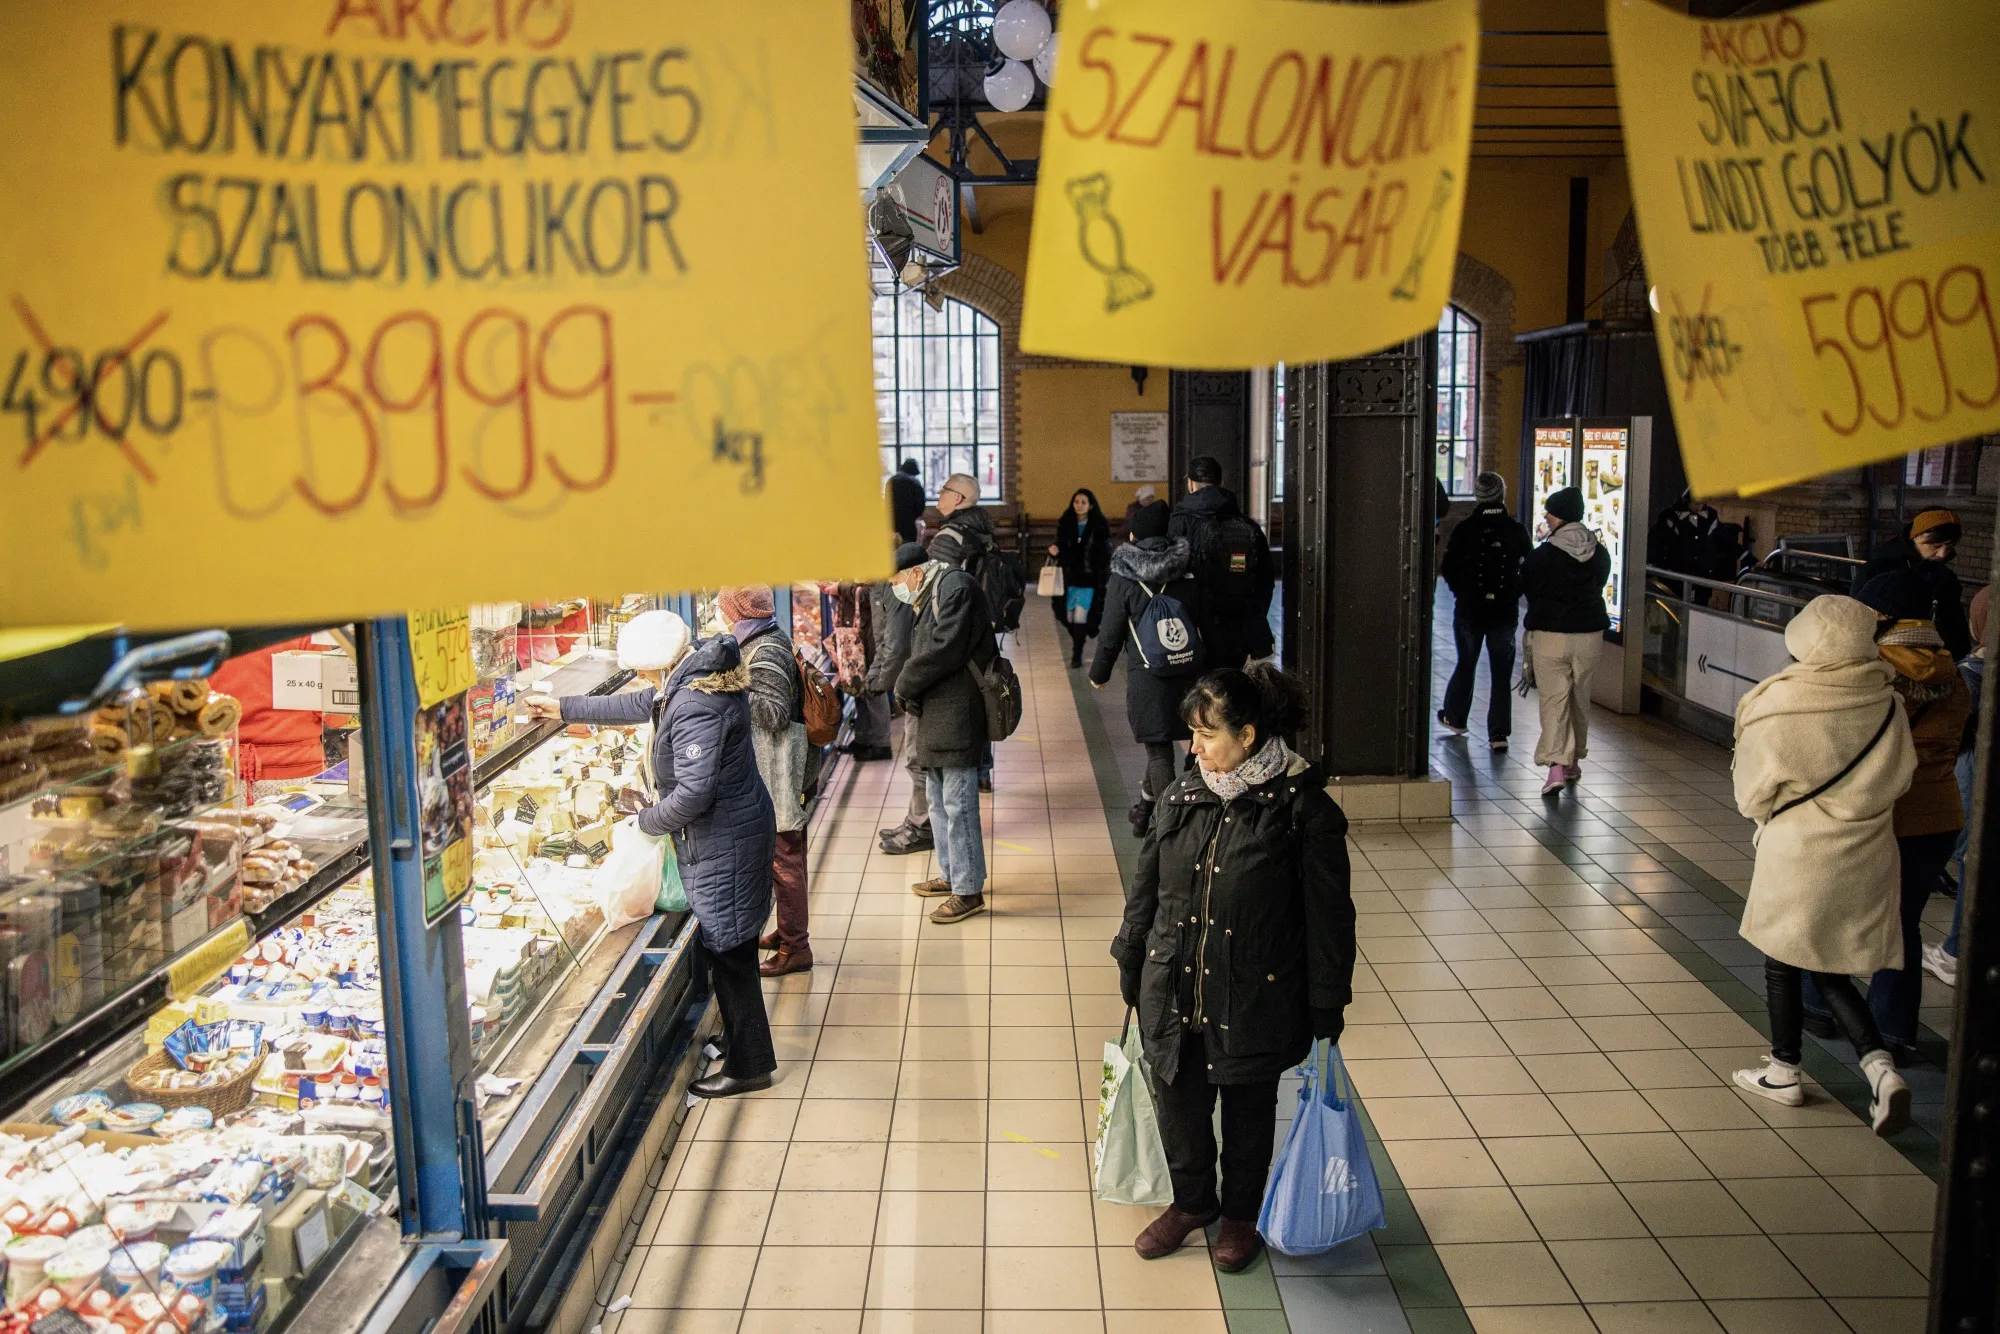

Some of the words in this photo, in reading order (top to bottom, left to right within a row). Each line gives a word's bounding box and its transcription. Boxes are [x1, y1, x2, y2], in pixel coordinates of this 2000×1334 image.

[112, 25, 703, 160] KONYAKMEGGYES
[1676, 155, 1777, 235] LINDT
[1782, 109, 1986, 221] GOLYÓK
[167, 174, 688, 281] SZALONCUKOR
[1801, 264, 2000, 436] 5999
[712, 415, 766, 495] kg
[286, 679, 297, 687] 25
[305, 680, 315, 688] 40
[317, 681, 323, 690] g
[1167, 650, 1194, 661] Budapest
[1169, 656, 1193, 666] Hungary
